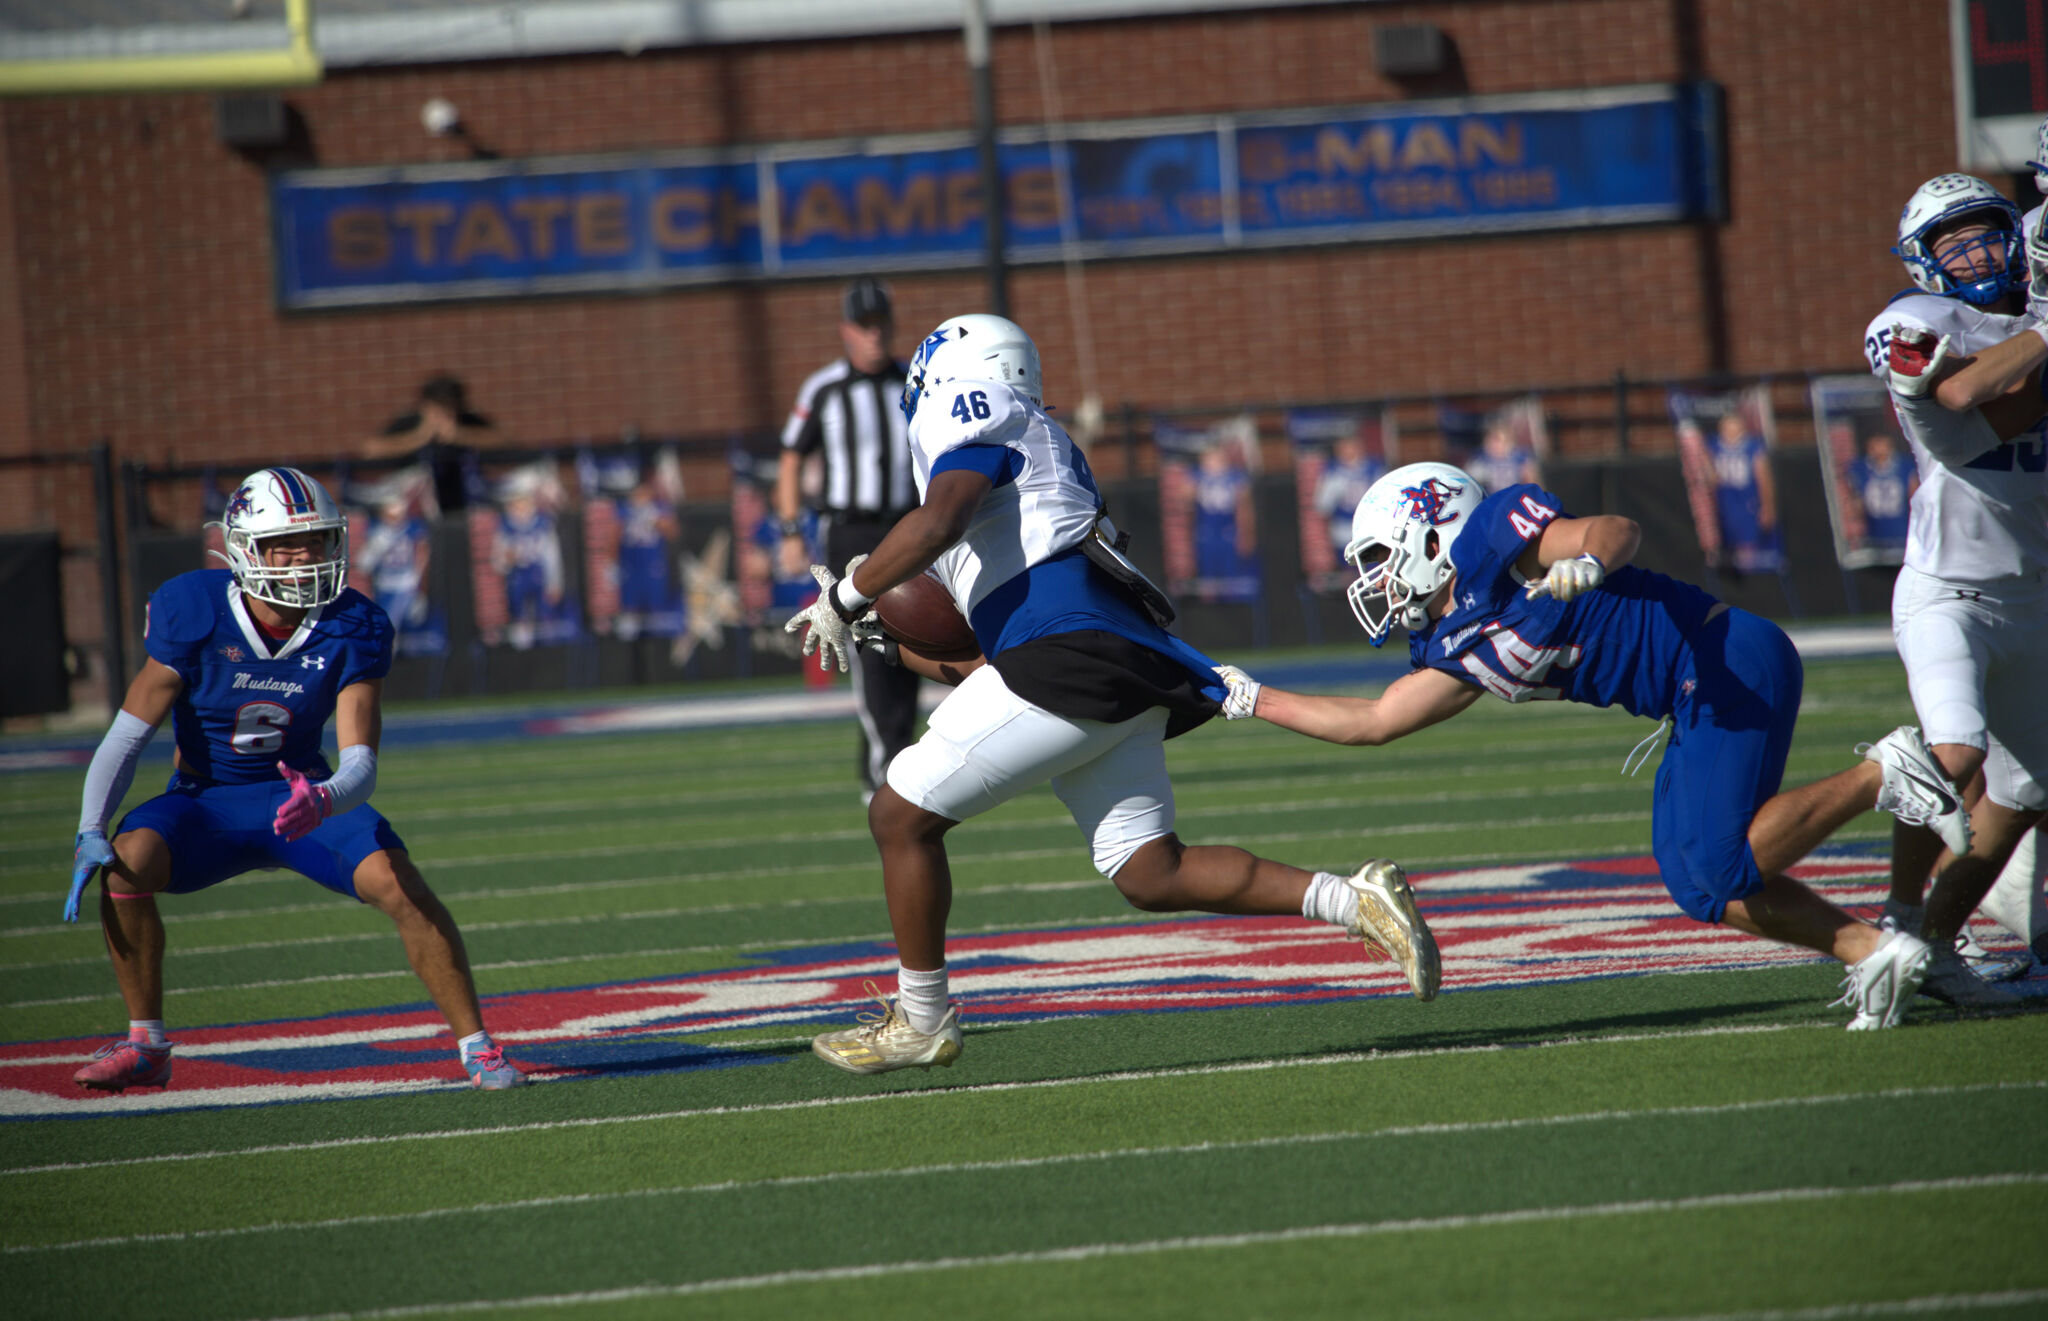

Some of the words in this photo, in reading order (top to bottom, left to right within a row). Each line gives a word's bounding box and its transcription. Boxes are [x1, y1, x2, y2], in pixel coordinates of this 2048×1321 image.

[328, 193, 631, 266] STATE
[651, 168, 1066, 251] CHAMPS
[1866, 328, 1891, 370] 25
[950, 390, 991, 425] 46
[1507, 494, 1558, 541] 44
[232, 672, 304, 698] Mustangs
[231, 701, 293, 754] 6
